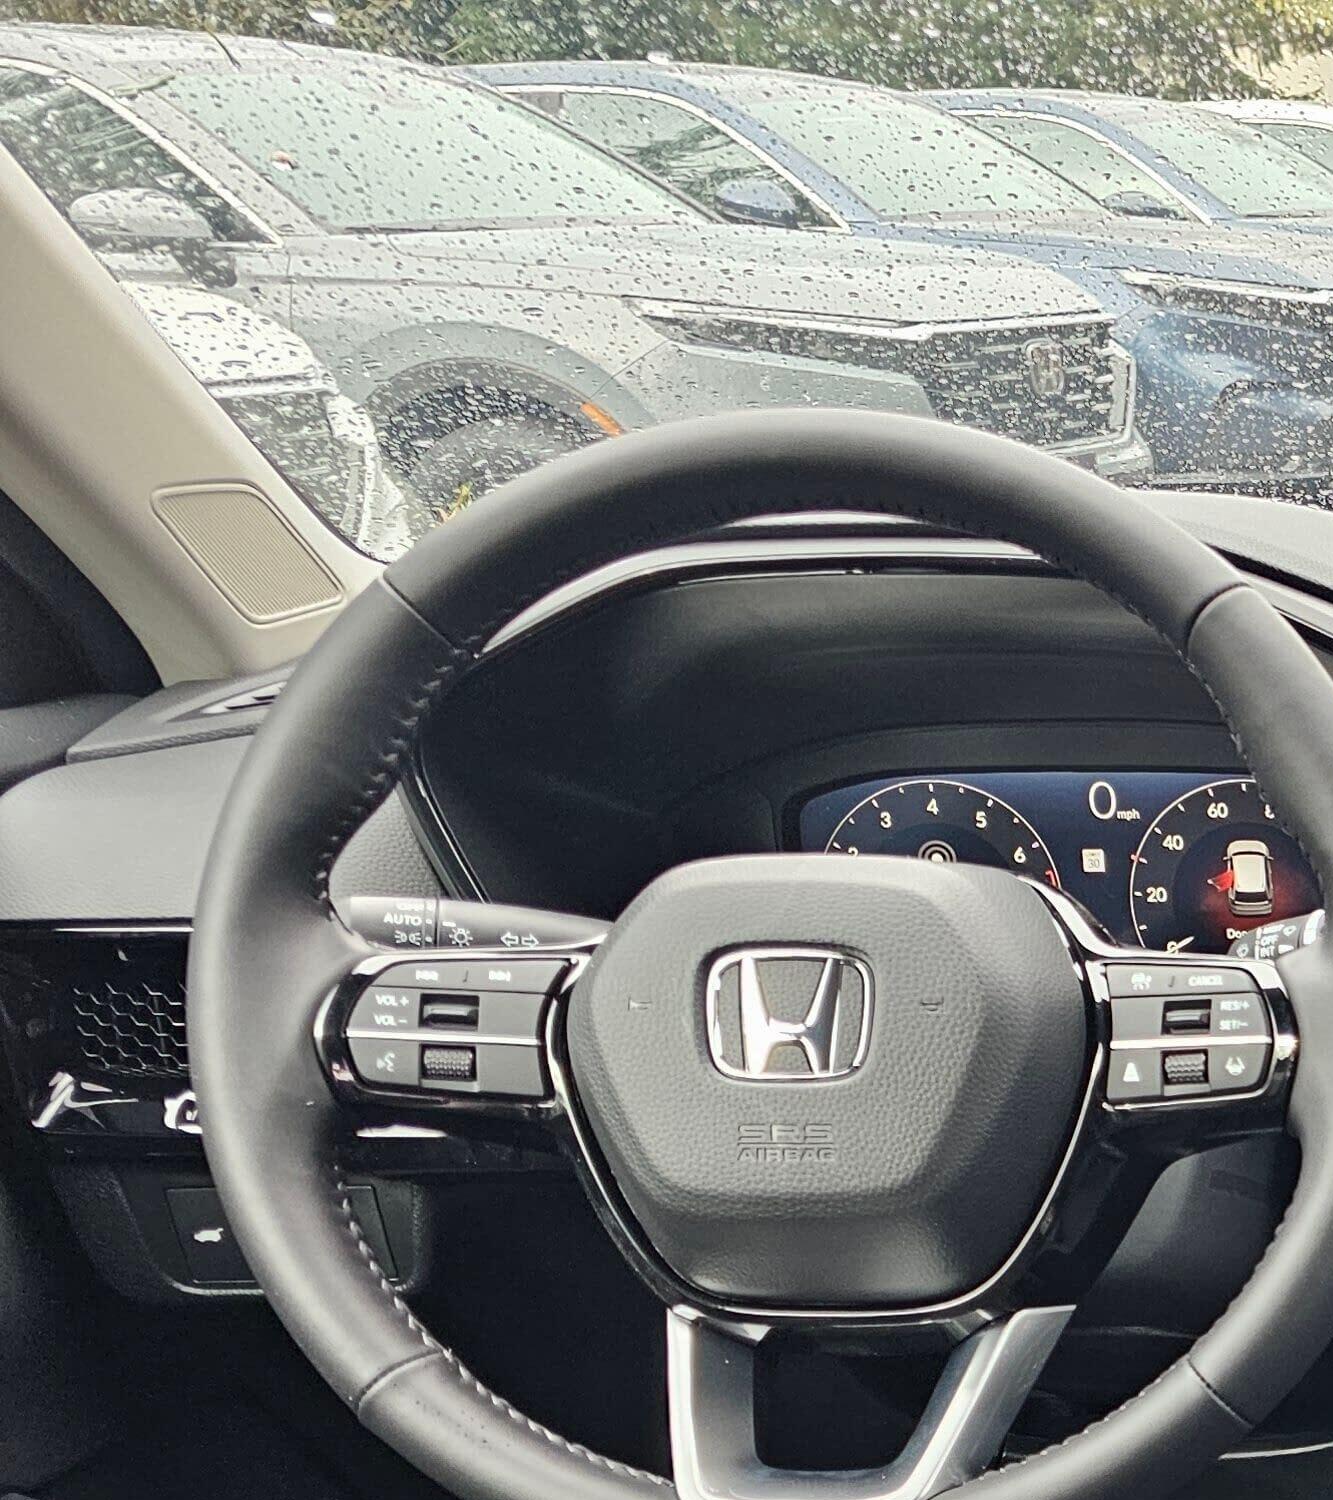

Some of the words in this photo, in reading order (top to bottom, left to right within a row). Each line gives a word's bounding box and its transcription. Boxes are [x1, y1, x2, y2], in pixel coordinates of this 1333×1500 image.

[926, 798, 940, 816] 4
[1088, 780, 1117, 820] 0
[1116, 808, 1141, 822] mph
[1206, 802, 1229, 819] 60
[880, 811, 893, 829] 3
[975, 811, 988, 829] 5
[1162, 834, 1185, 851] 40
[1013, 846, 1027, 864] 6
[1146, 886, 1168, 903] 20
[383, 912, 423, 926] AUTO
[1187, 975, 1224, 987] CANCEL
[375, 994, 398, 1007] VOL
[373, 1013, 397, 1027] VOL
[737, 1123, 833, 1143] SRS
[736, 1146, 835, 1162] AIRBAG
